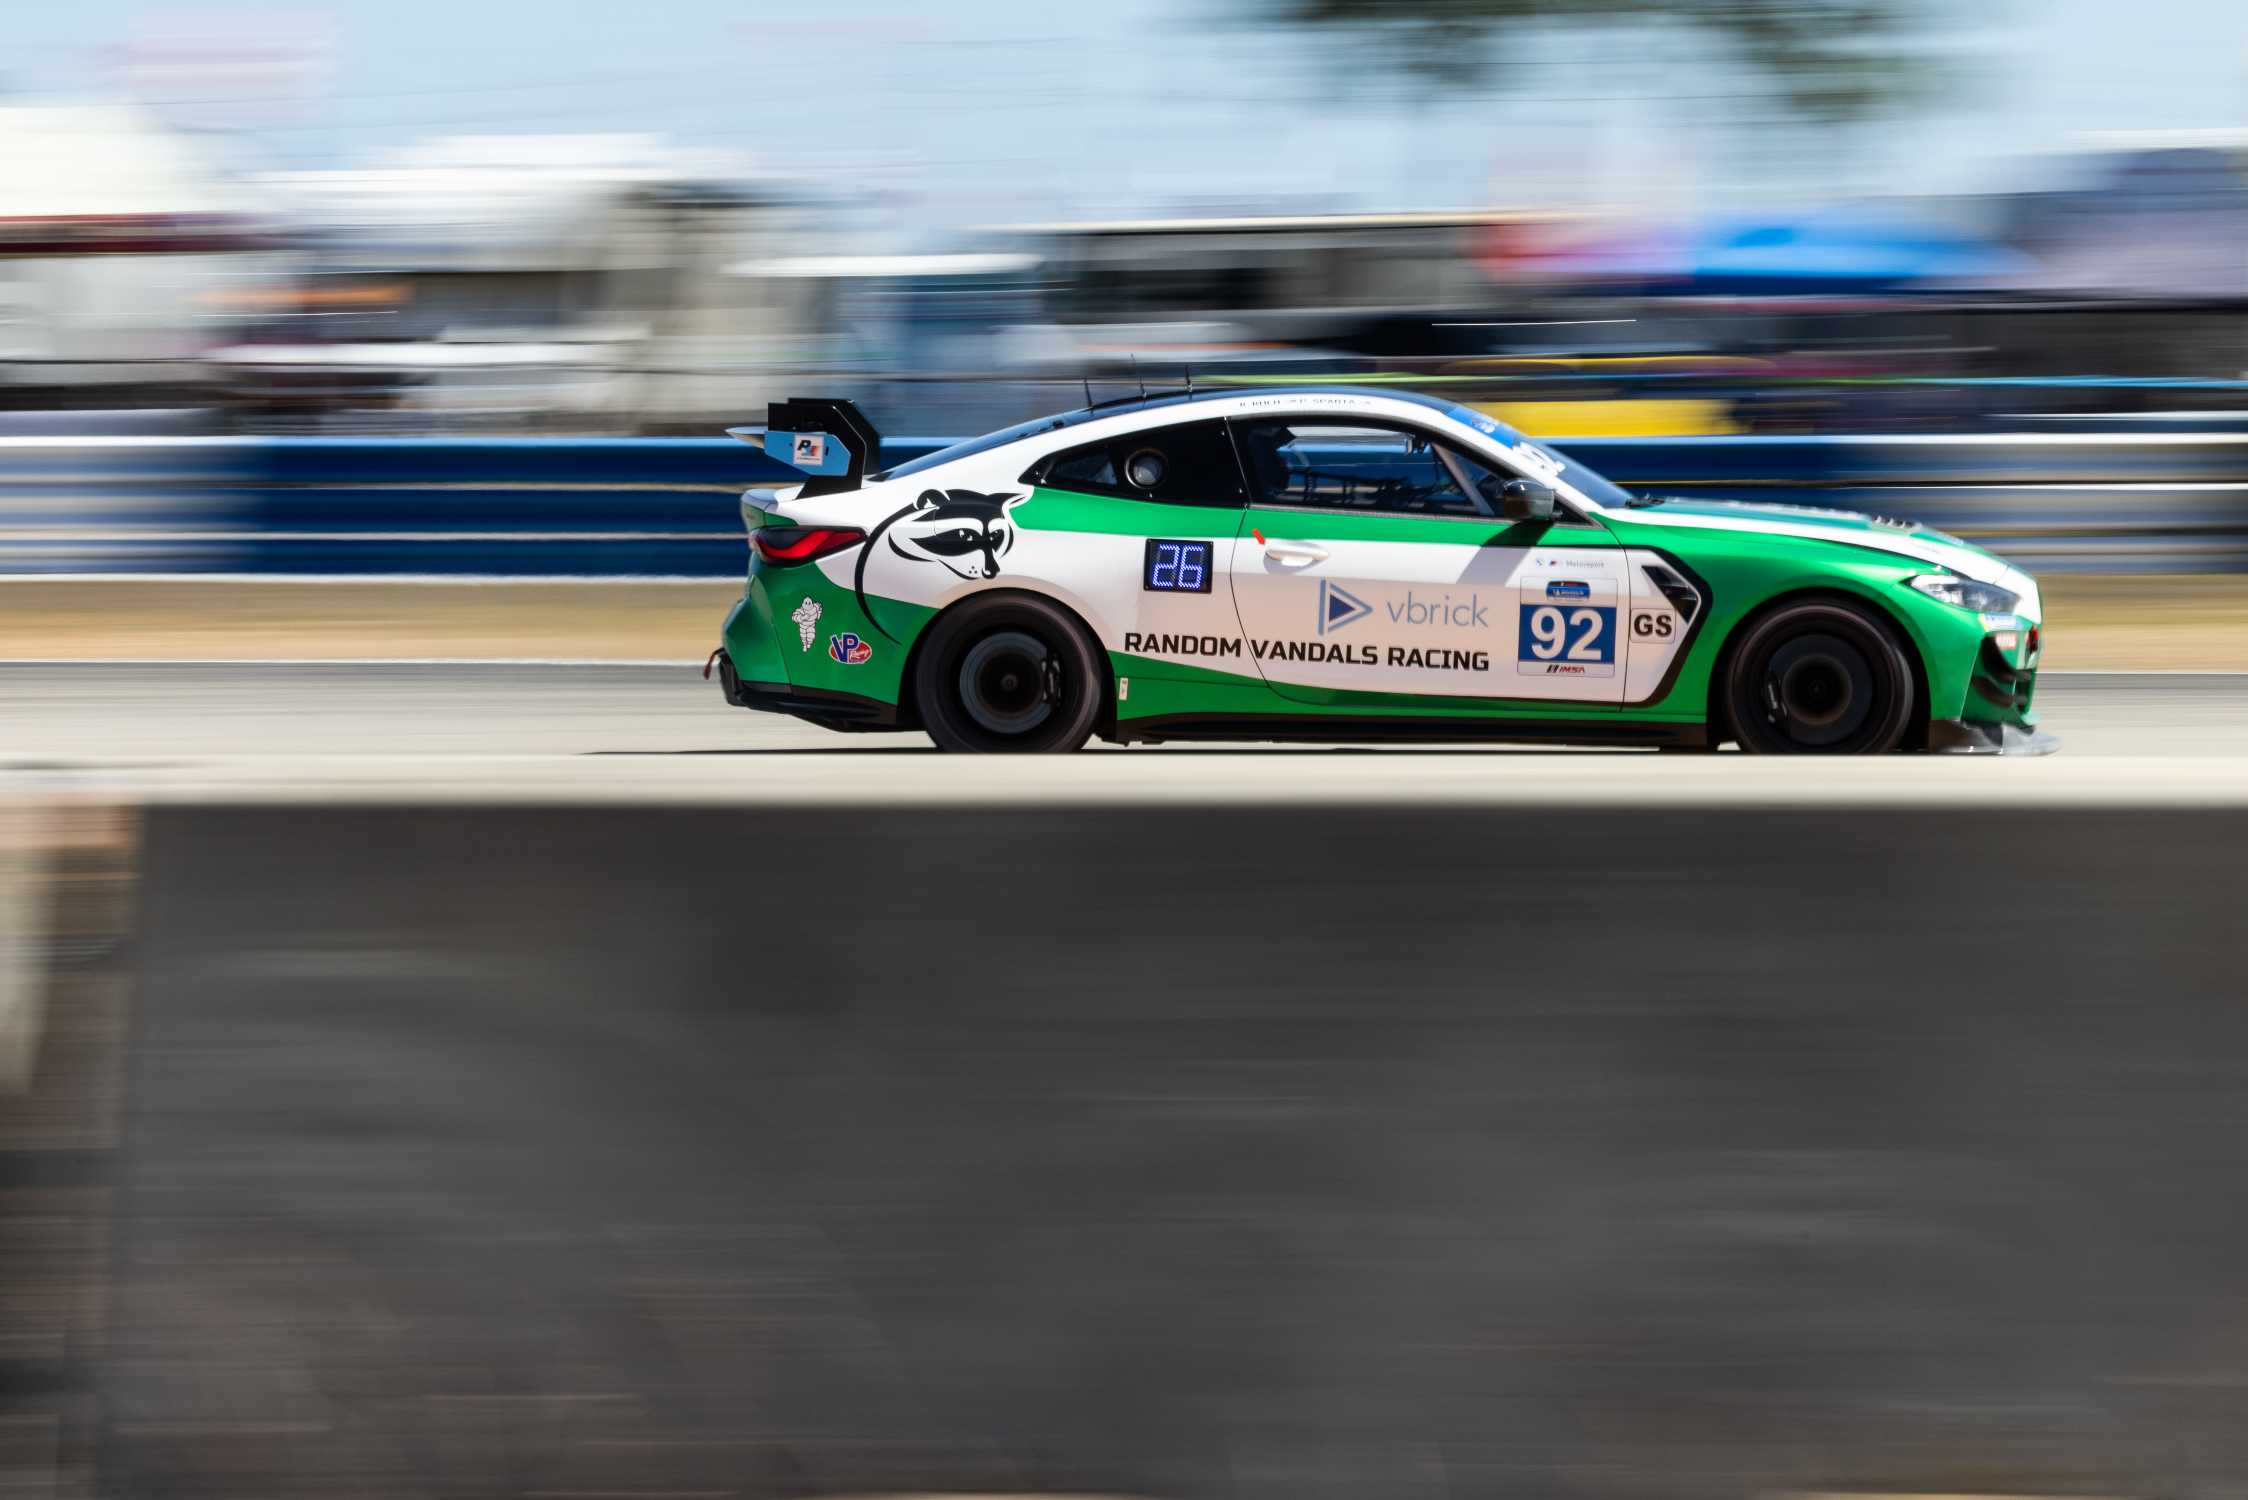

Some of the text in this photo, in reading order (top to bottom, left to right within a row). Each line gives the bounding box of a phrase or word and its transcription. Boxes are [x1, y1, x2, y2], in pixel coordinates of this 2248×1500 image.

[1153, 544, 1203, 588] 26
[1387, 591, 1489, 627] vbrick
[1633, 614, 1672, 637] GS
[830, 633, 859, 662] VP
[1125, 632, 1489, 671] RANDOM VANDALS RACING
[1531, 607, 1603, 660] 92
